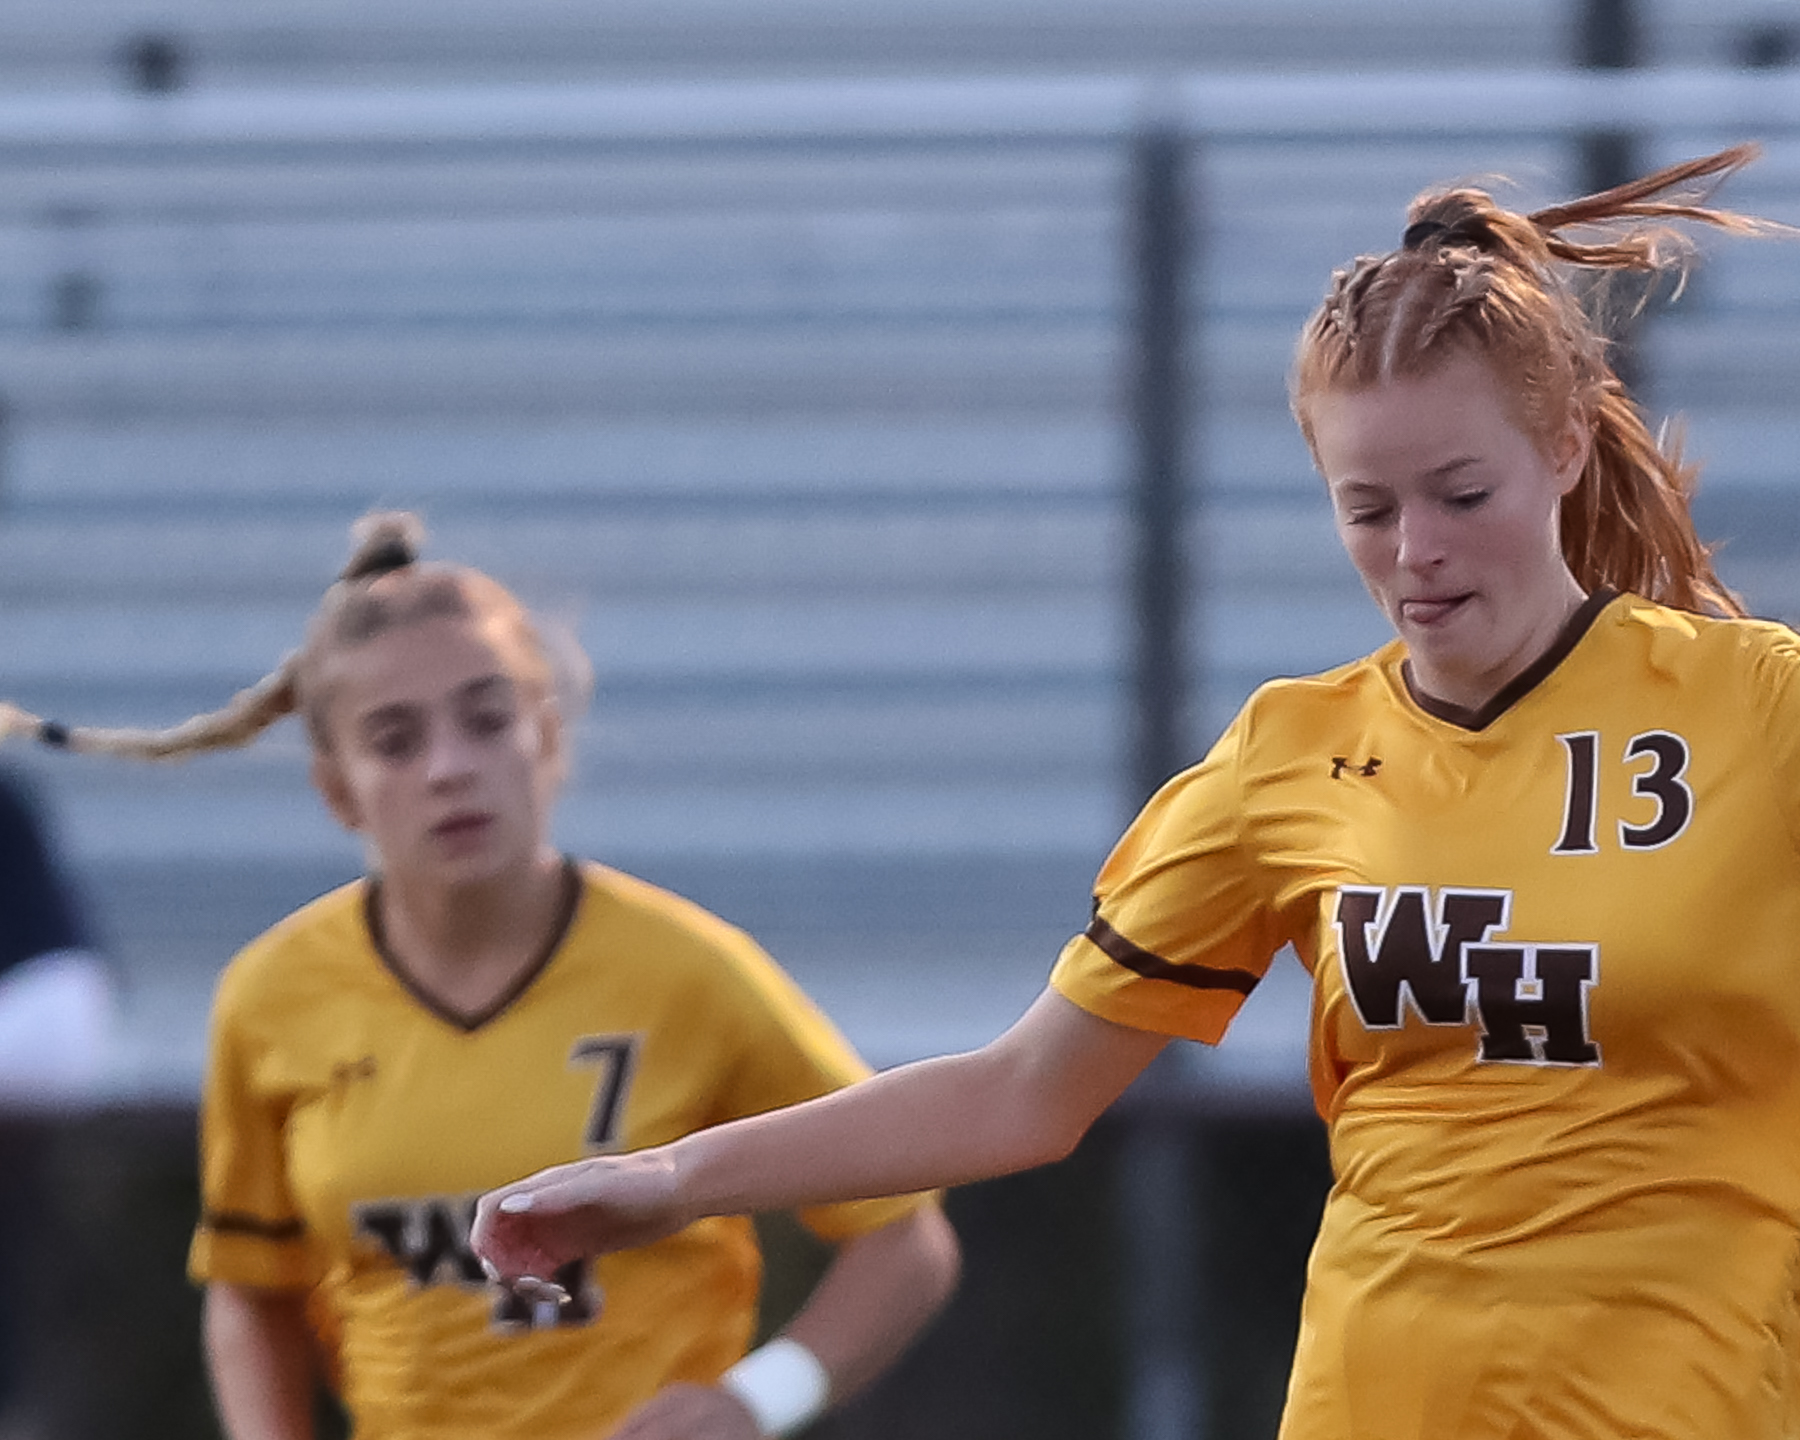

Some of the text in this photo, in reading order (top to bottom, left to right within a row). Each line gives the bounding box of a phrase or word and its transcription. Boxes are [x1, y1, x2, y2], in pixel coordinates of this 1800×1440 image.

[1550, 730, 1694, 855] 13
[1332, 885, 1602, 1068] WH
[567, 1033, 647, 1154] 7
